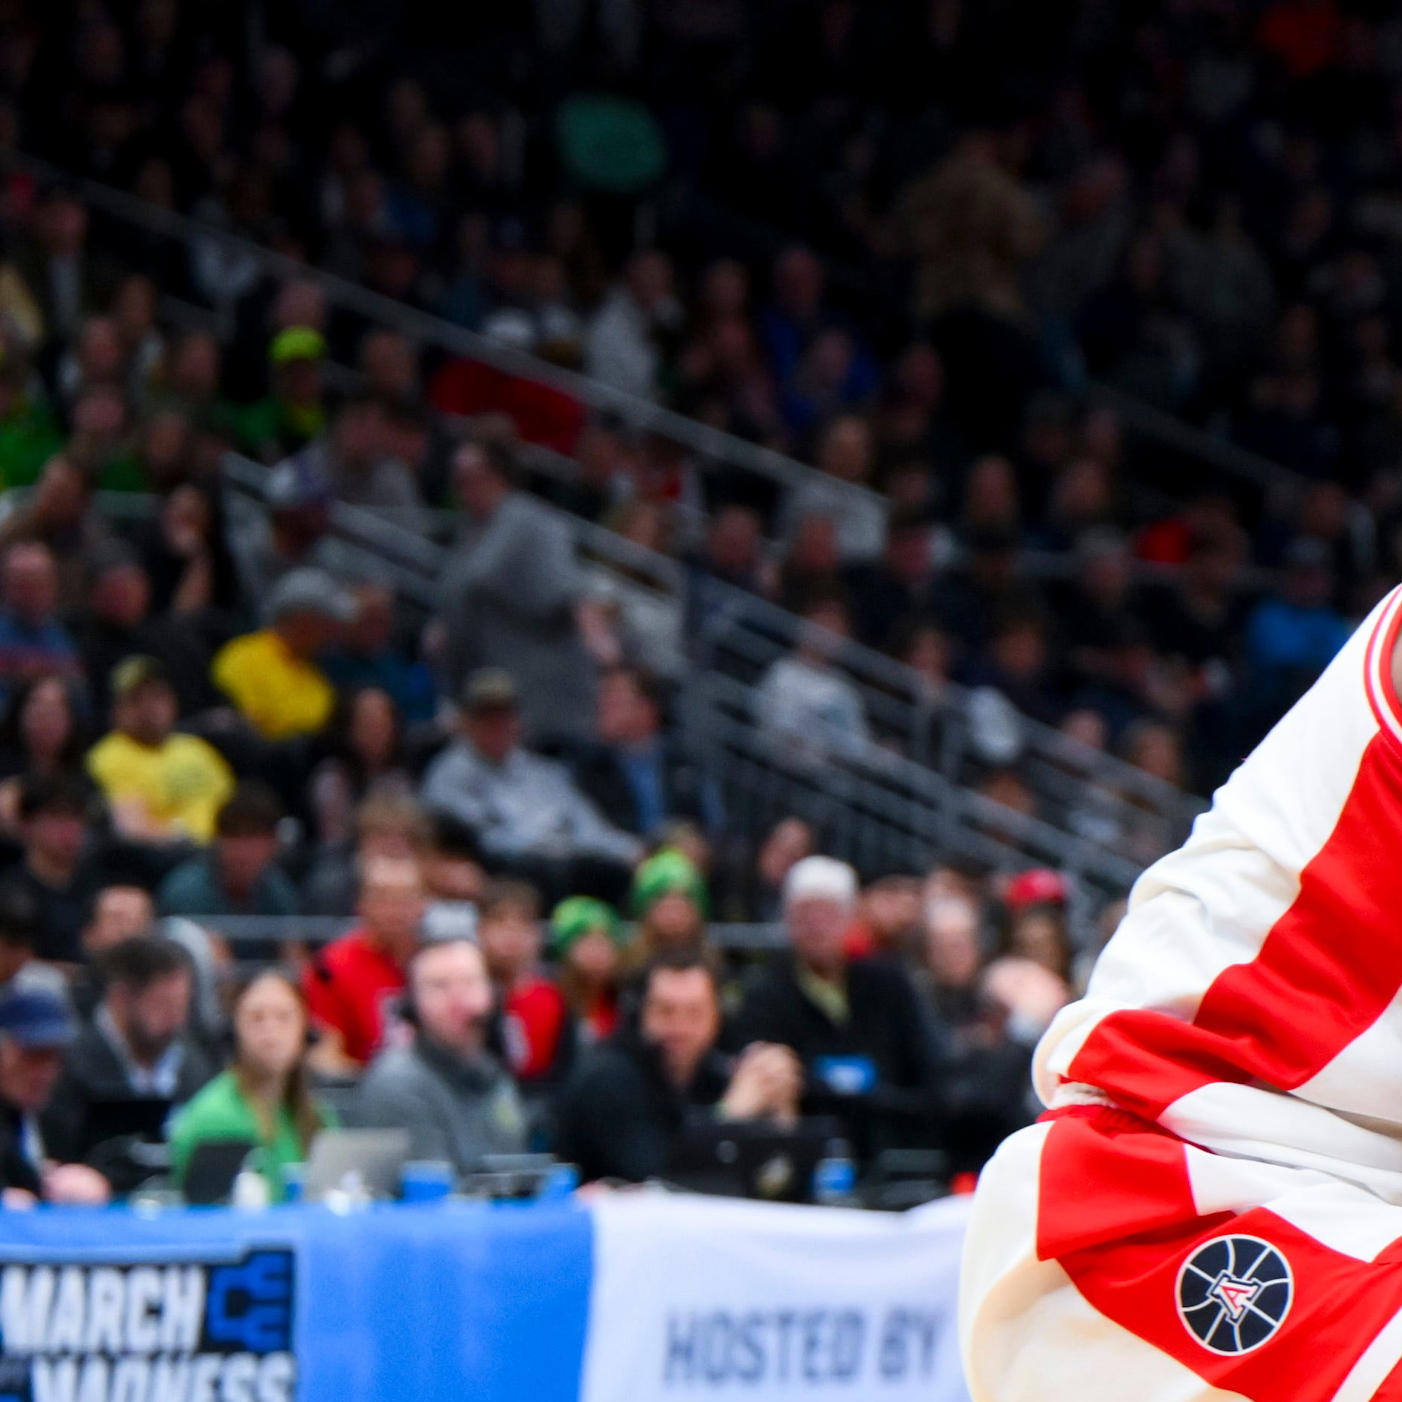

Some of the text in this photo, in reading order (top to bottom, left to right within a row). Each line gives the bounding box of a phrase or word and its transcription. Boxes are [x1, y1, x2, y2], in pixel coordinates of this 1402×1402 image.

[0, 1263, 206, 1353] MARCH
[662, 1304, 946, 1388] HOSTED BY
